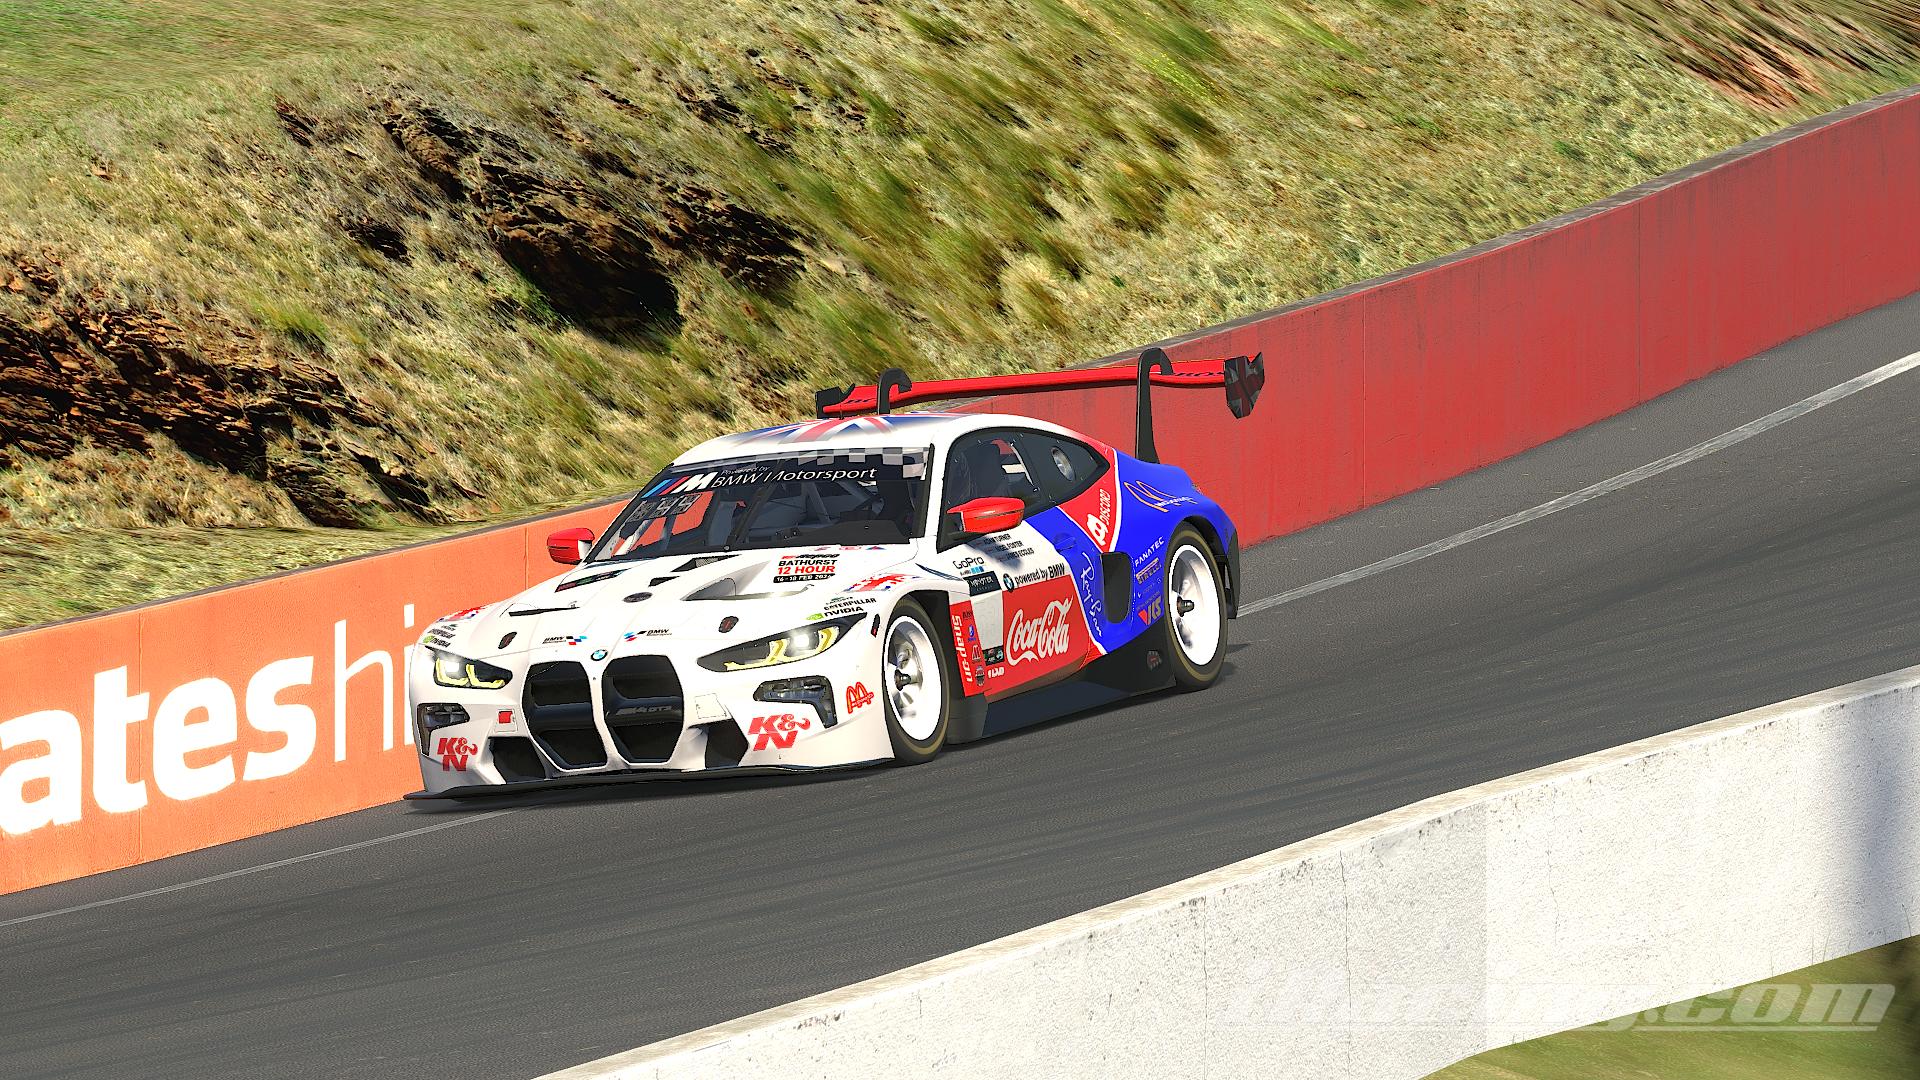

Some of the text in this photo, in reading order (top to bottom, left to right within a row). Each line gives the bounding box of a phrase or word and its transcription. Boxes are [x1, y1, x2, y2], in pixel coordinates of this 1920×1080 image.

[712, 472, 763, 488] BMW
[764, 467, 878, 484] Motorsport
[1135, 537, 1164, 567] FANATEC
[778, 559, 838, 567] BATHURST
[778, 566, 836, 575] 12 HOUR
[952, 556, 985, 569] GoPro
[1015, 562, 1065, 586] powered by BMW
[823, 598, 877, 611] CATERPILLAR
[747, 713, 811, 751] K&N
